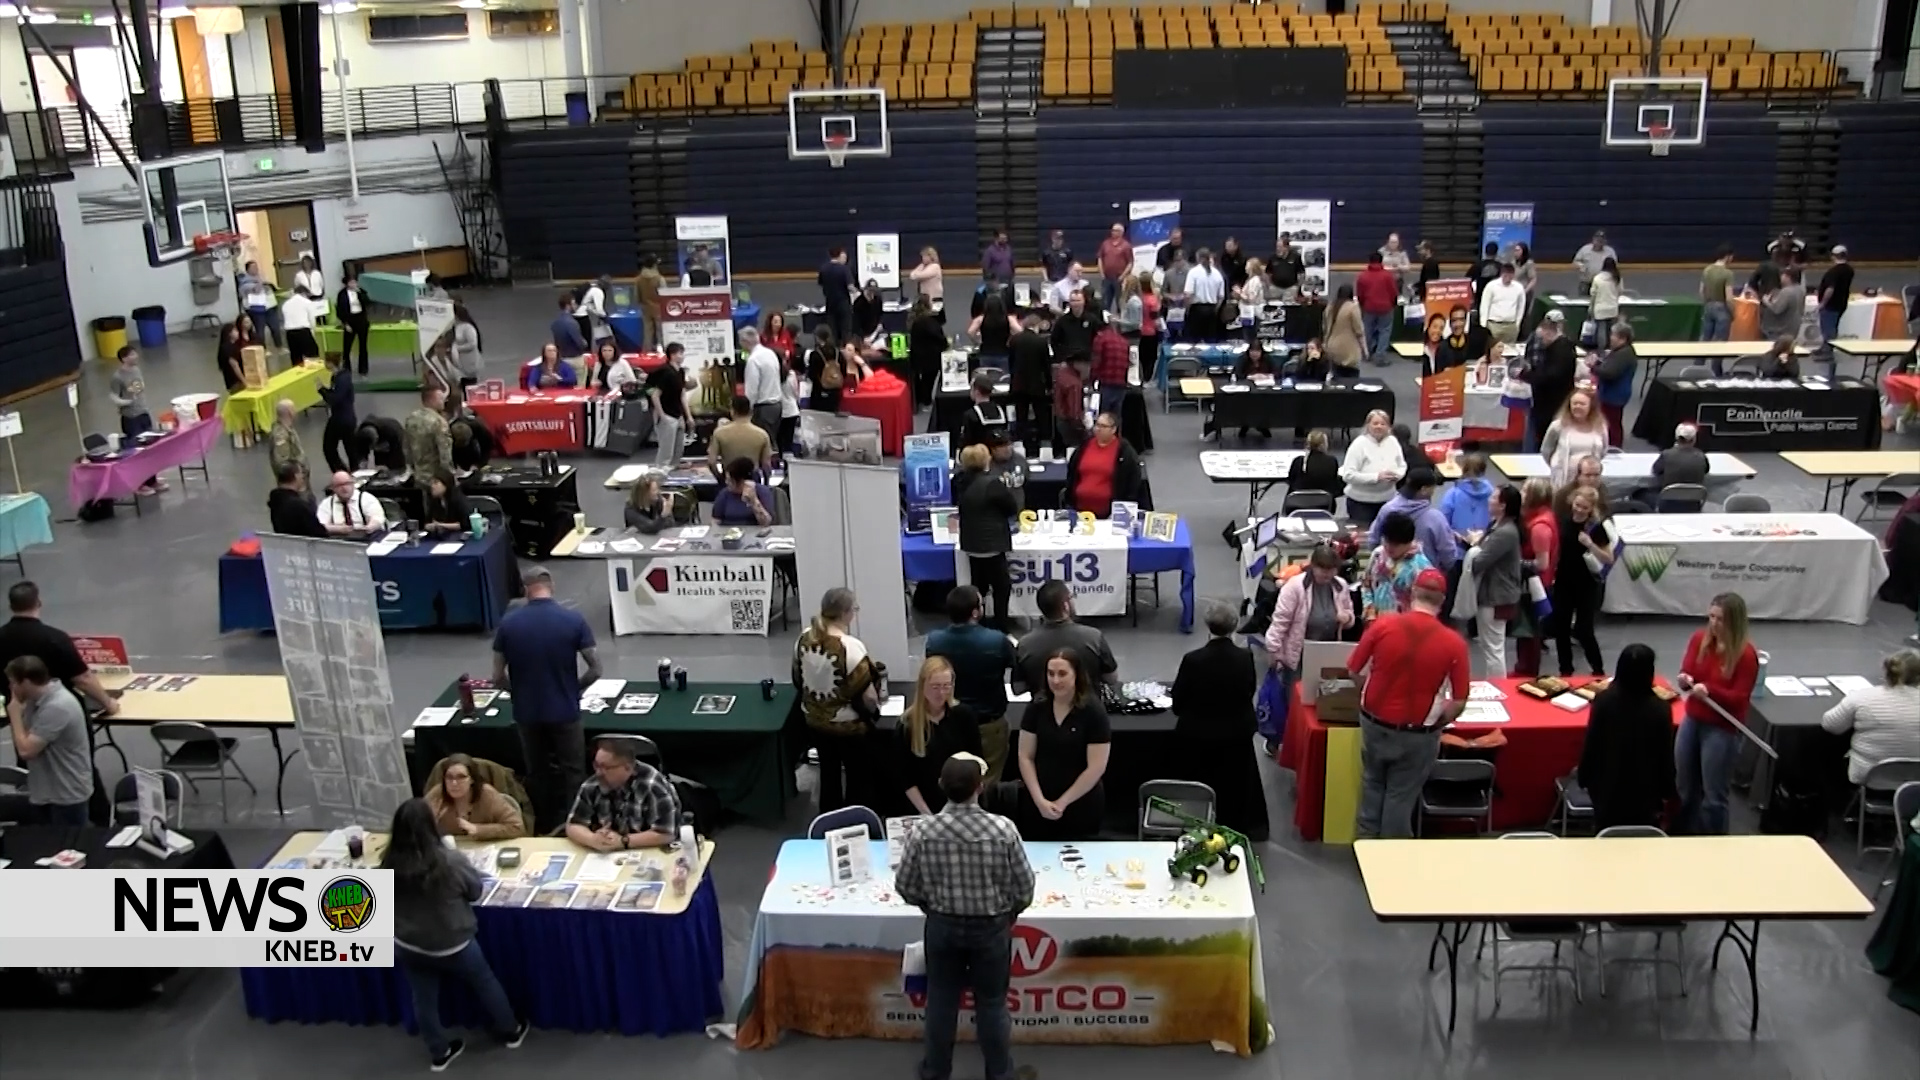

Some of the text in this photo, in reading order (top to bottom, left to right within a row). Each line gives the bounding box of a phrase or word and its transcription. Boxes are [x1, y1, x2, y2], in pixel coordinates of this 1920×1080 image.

[1726, 408, 1803, 420] Panhandle
[506, 420, 565, 433] SCOTTSBLUFF
[1770, 421, 1858, 432] Public Health District
[674, 564, 766, 582] Kimball
[1008, 552, 1100, 584] su13
[1677, 559, 1807, 574] Western Sugar Cooperative
[677, 586, 767, 597] Health Services
[908, 985, 1127, 1012] ESTCO
[1074, 1015, 1150, 1026] SUCCESS
